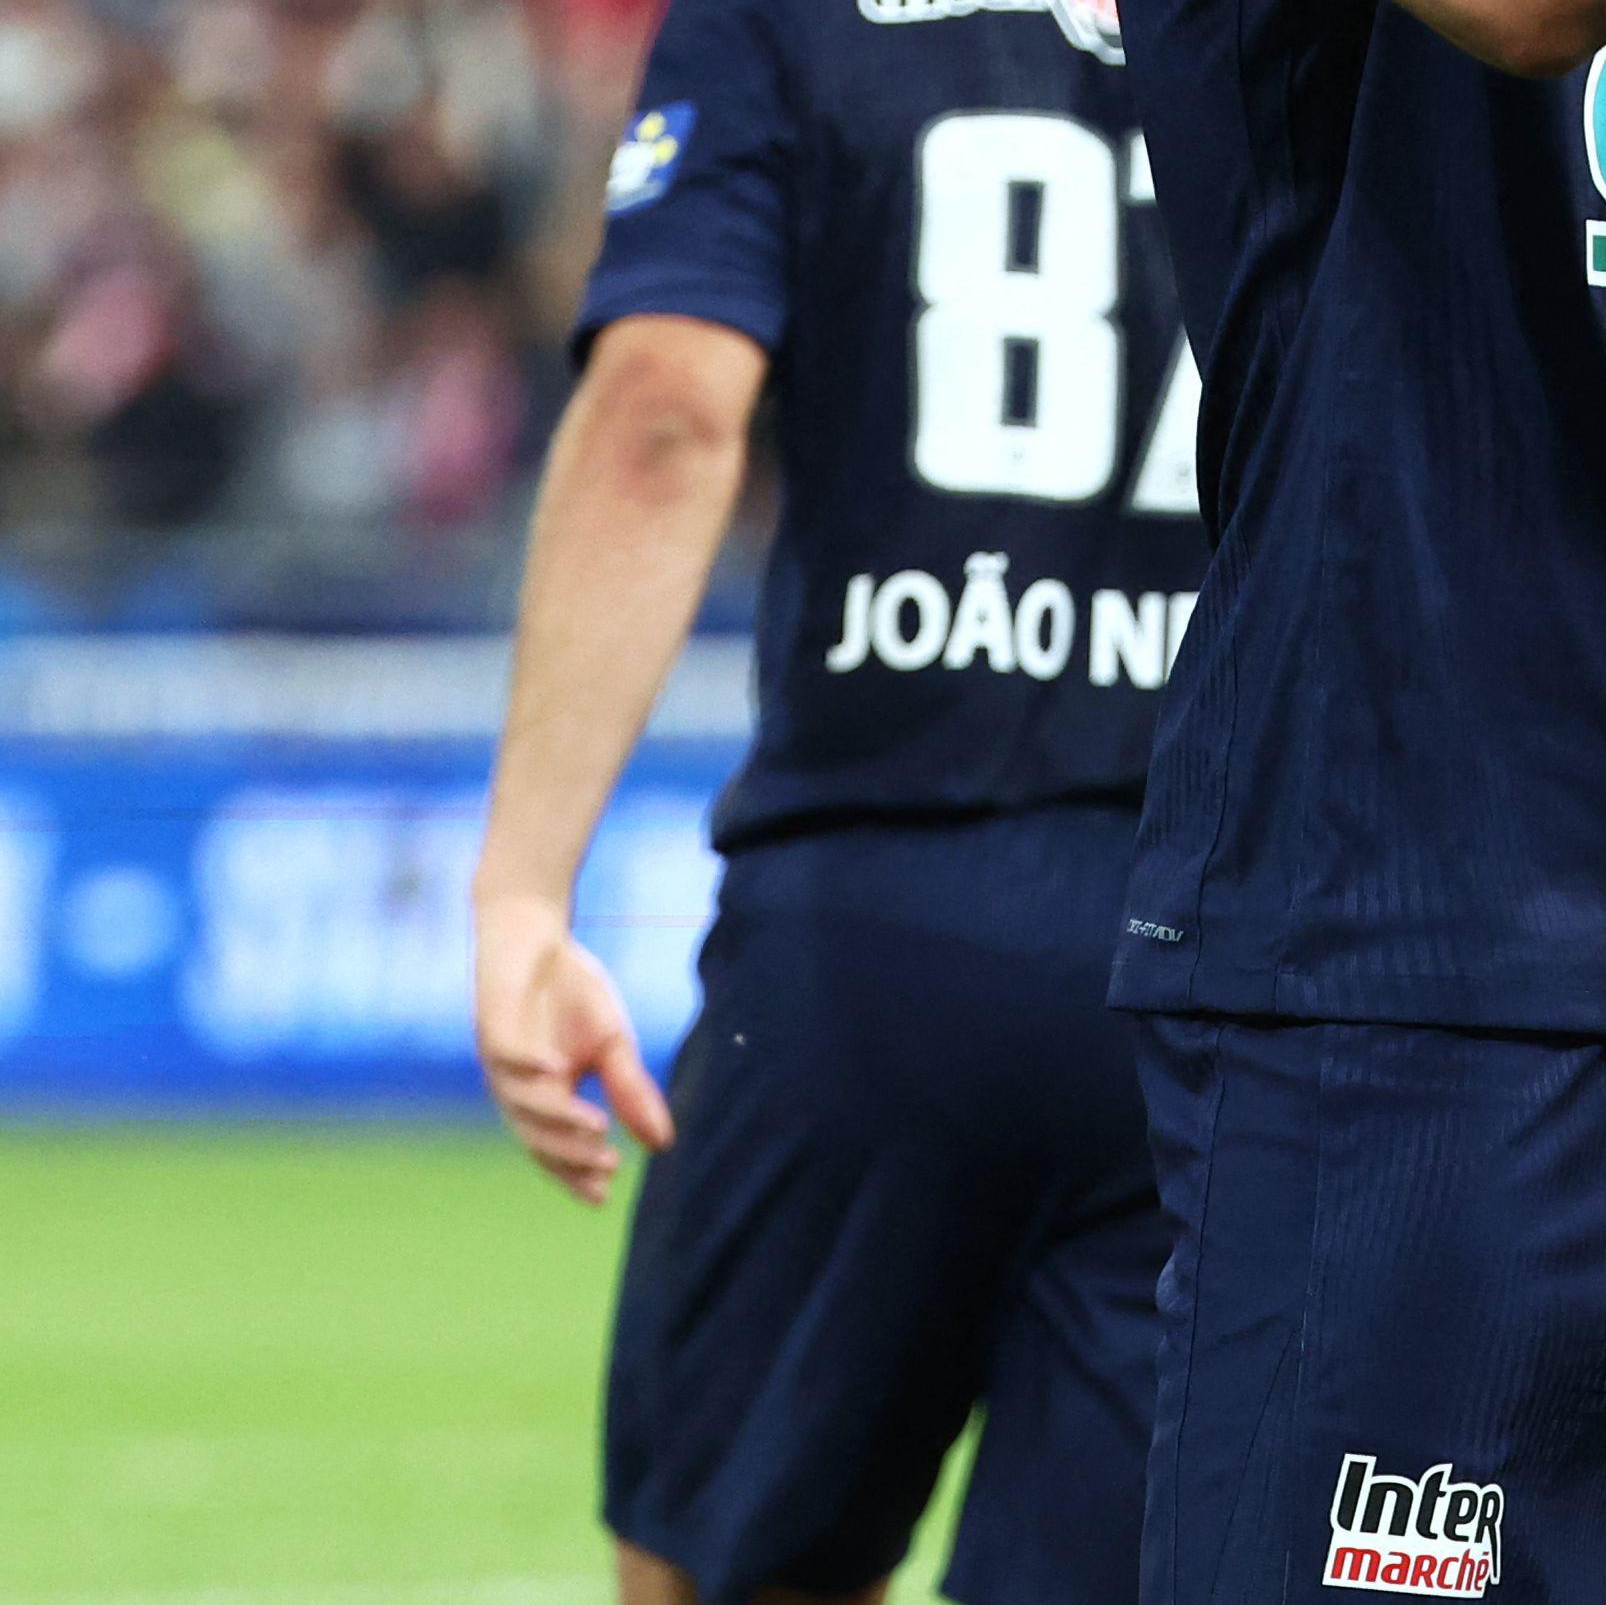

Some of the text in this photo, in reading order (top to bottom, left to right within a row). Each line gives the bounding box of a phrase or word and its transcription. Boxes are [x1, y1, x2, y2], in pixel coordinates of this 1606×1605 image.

[824, 550, 1077, 682] JOÃO
[1335, 1459, 1502, 1559] Inter
[1330, 1547, 1490, 1592] marché
